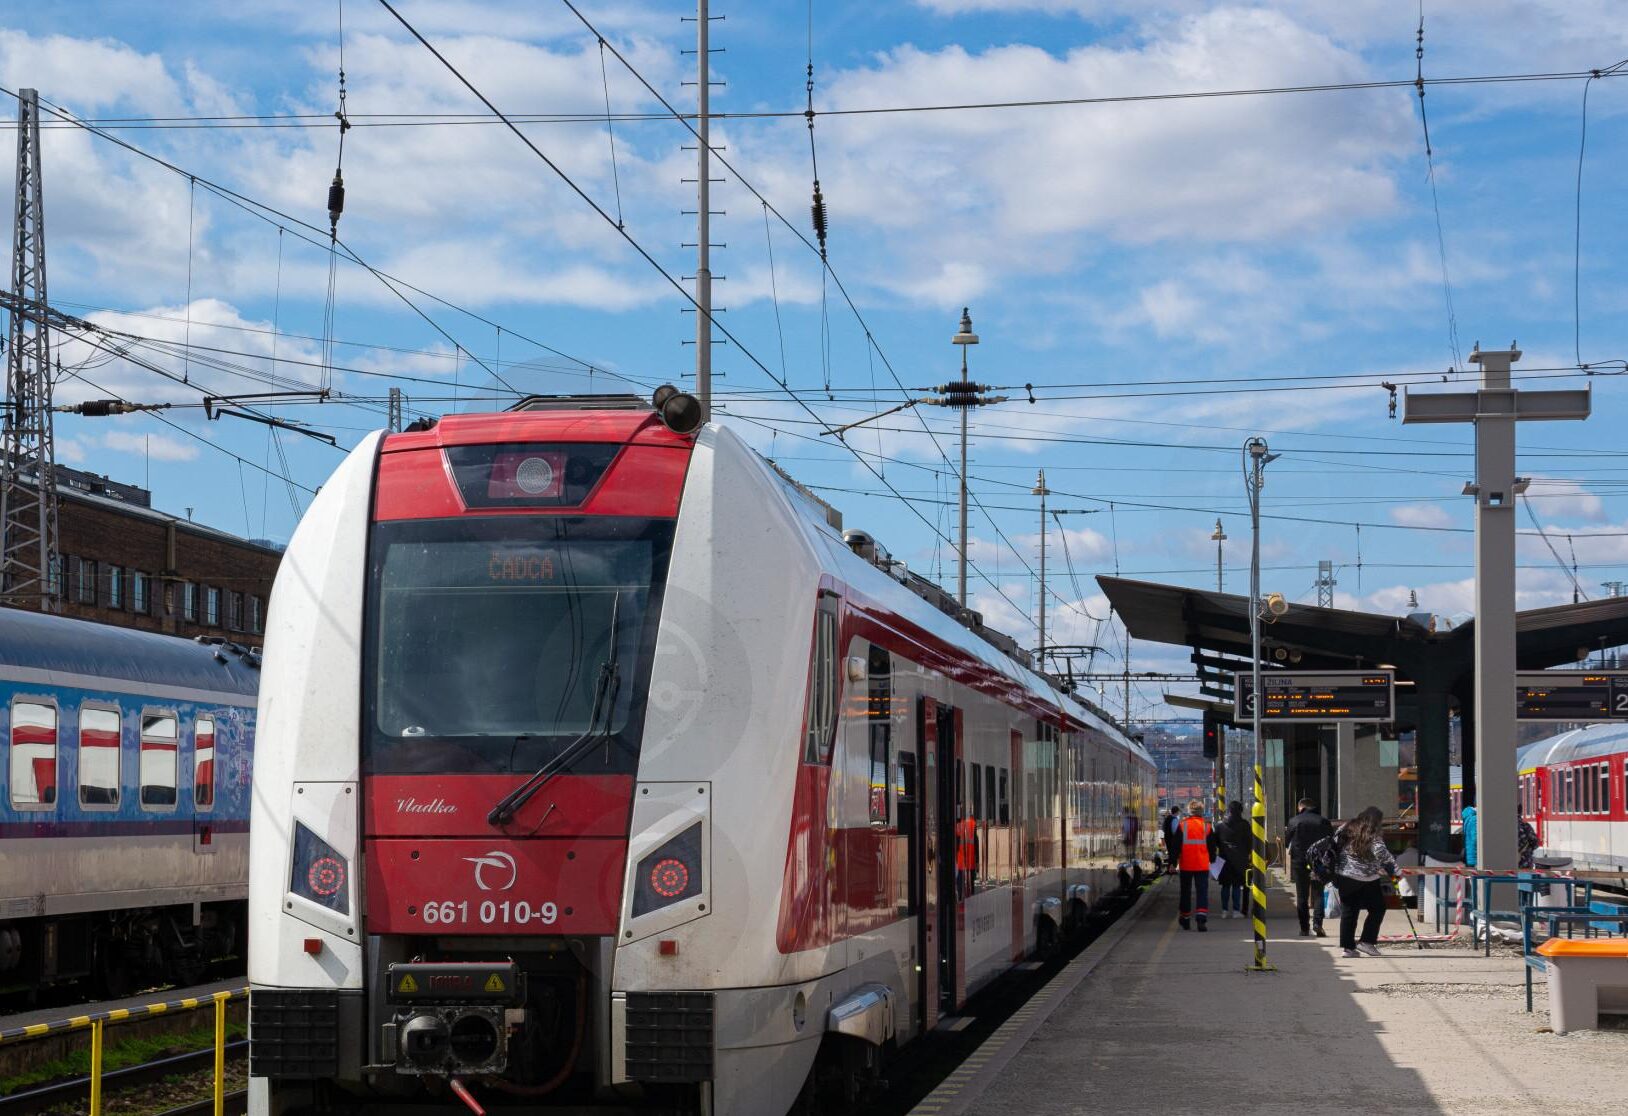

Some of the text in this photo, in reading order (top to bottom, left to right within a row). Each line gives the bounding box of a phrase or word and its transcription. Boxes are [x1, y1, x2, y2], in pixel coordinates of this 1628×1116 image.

[1616, 693, 1628, 711] 2
[396, 797, 457, 813] Vladka
[423, 900, 558, 925] 661 010-9
